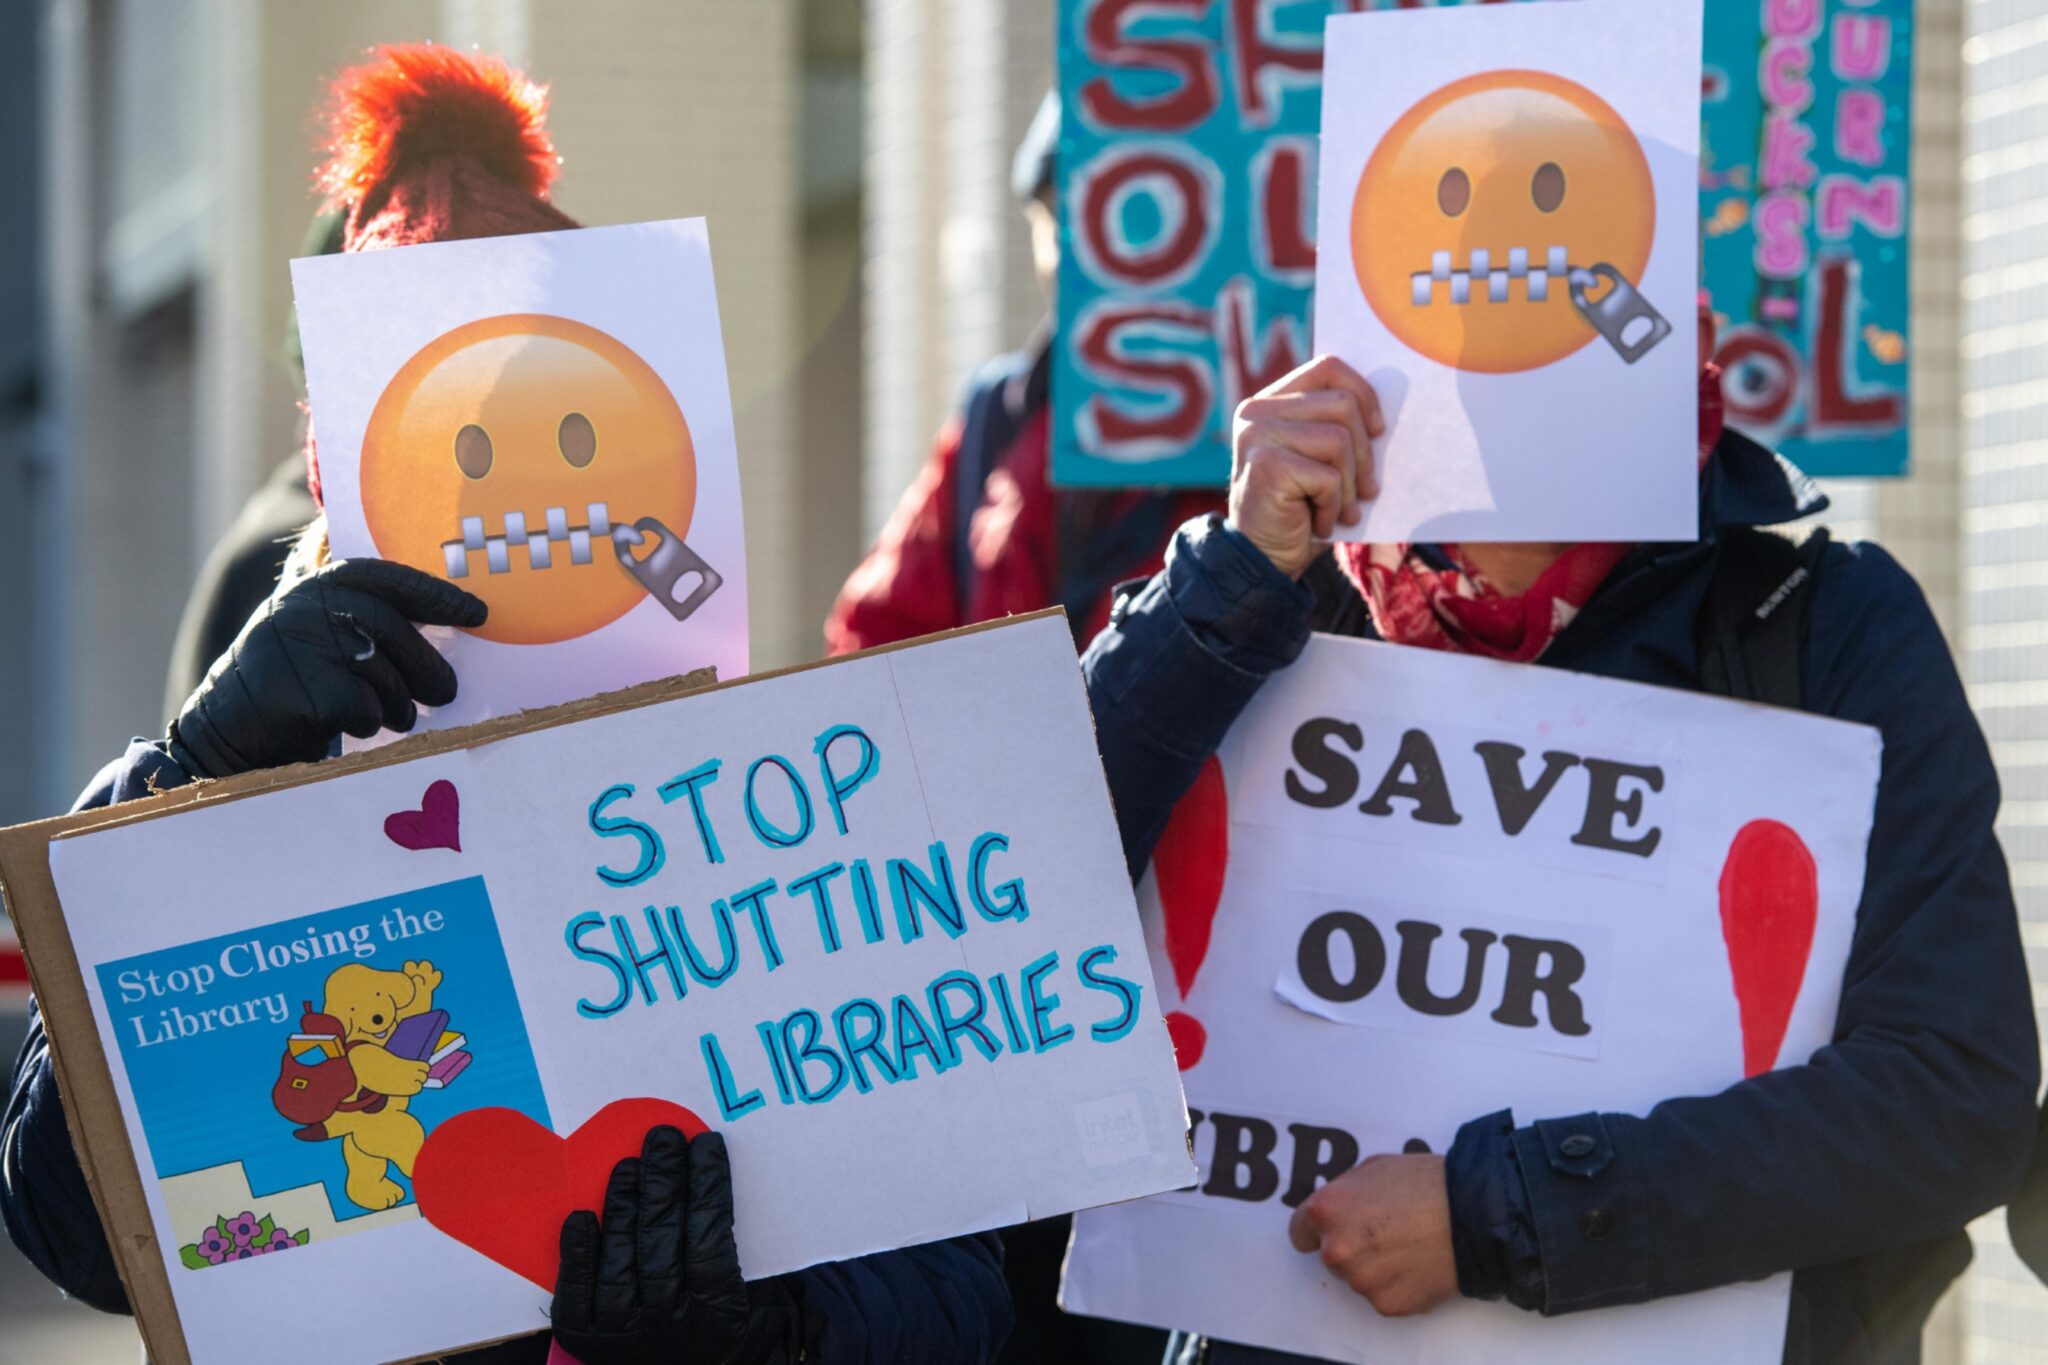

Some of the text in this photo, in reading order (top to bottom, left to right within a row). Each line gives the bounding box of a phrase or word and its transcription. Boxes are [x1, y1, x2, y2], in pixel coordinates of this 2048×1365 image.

[588, 724, 880, 888] STOP
[1285, 717, 1665, 858] SAVE
[117, 907, 445, 1005] Stop Closing the
[564, 832, 1030, 1020] SHUTTING
[1297, 910, 1591, 1037] OUR
[129, 993, 289, 1048] Library
[700, 944, 1142, 1122] LIBRARIES
